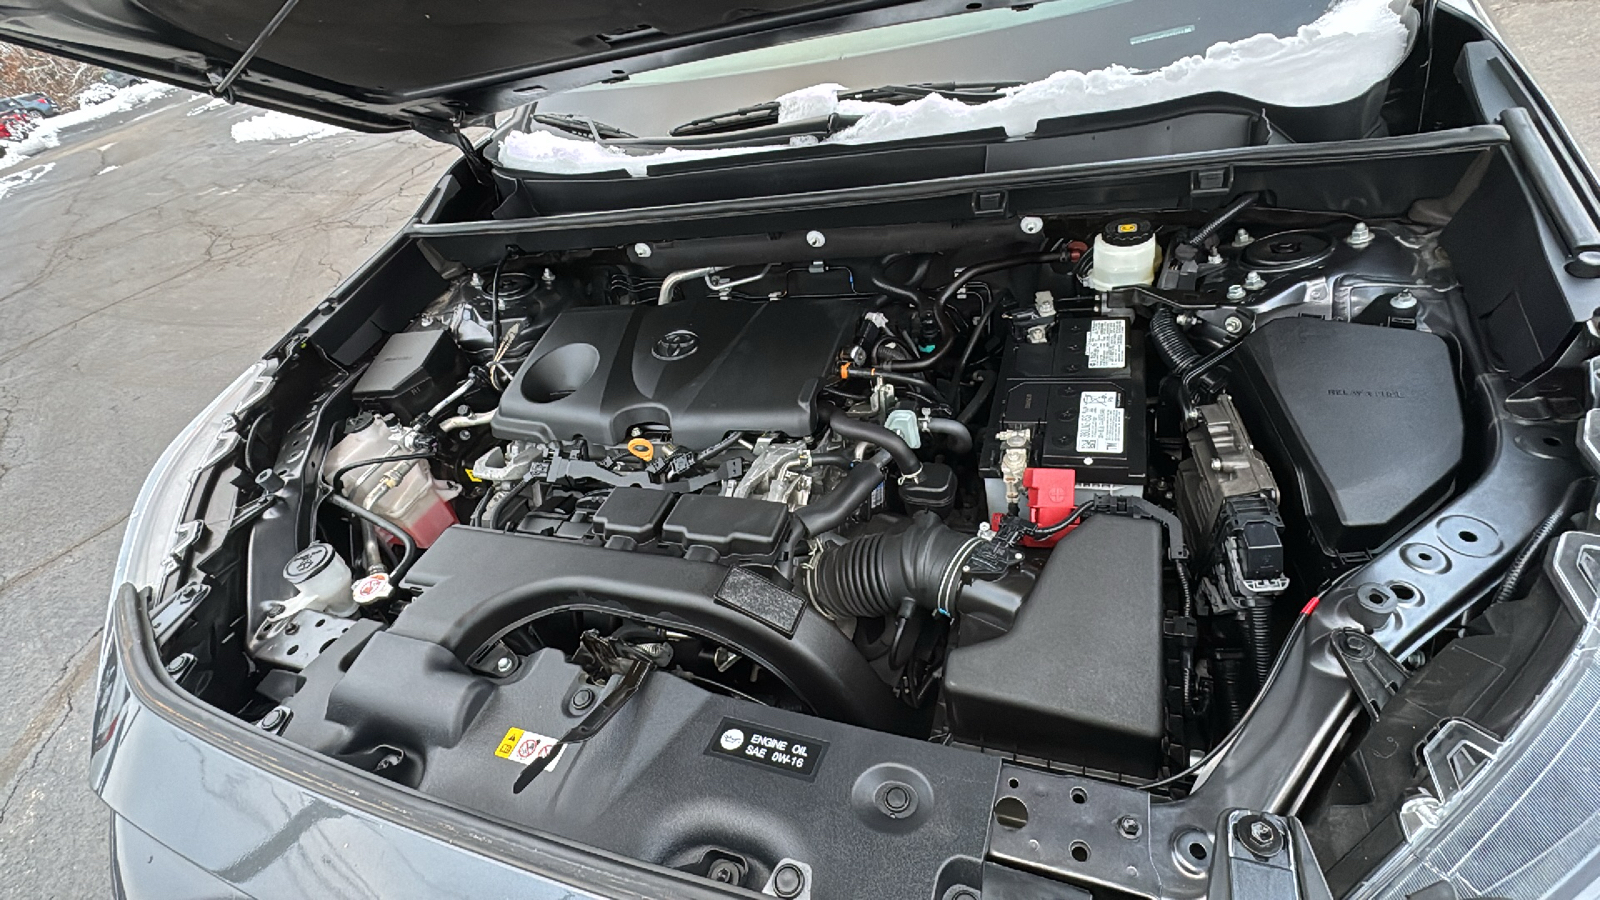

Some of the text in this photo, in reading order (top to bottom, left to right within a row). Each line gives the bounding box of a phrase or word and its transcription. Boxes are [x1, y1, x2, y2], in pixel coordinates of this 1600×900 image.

[745, 744, 804, 768] SAE 0W-16
[750, 733, 808, 757] ENGINE OIL
